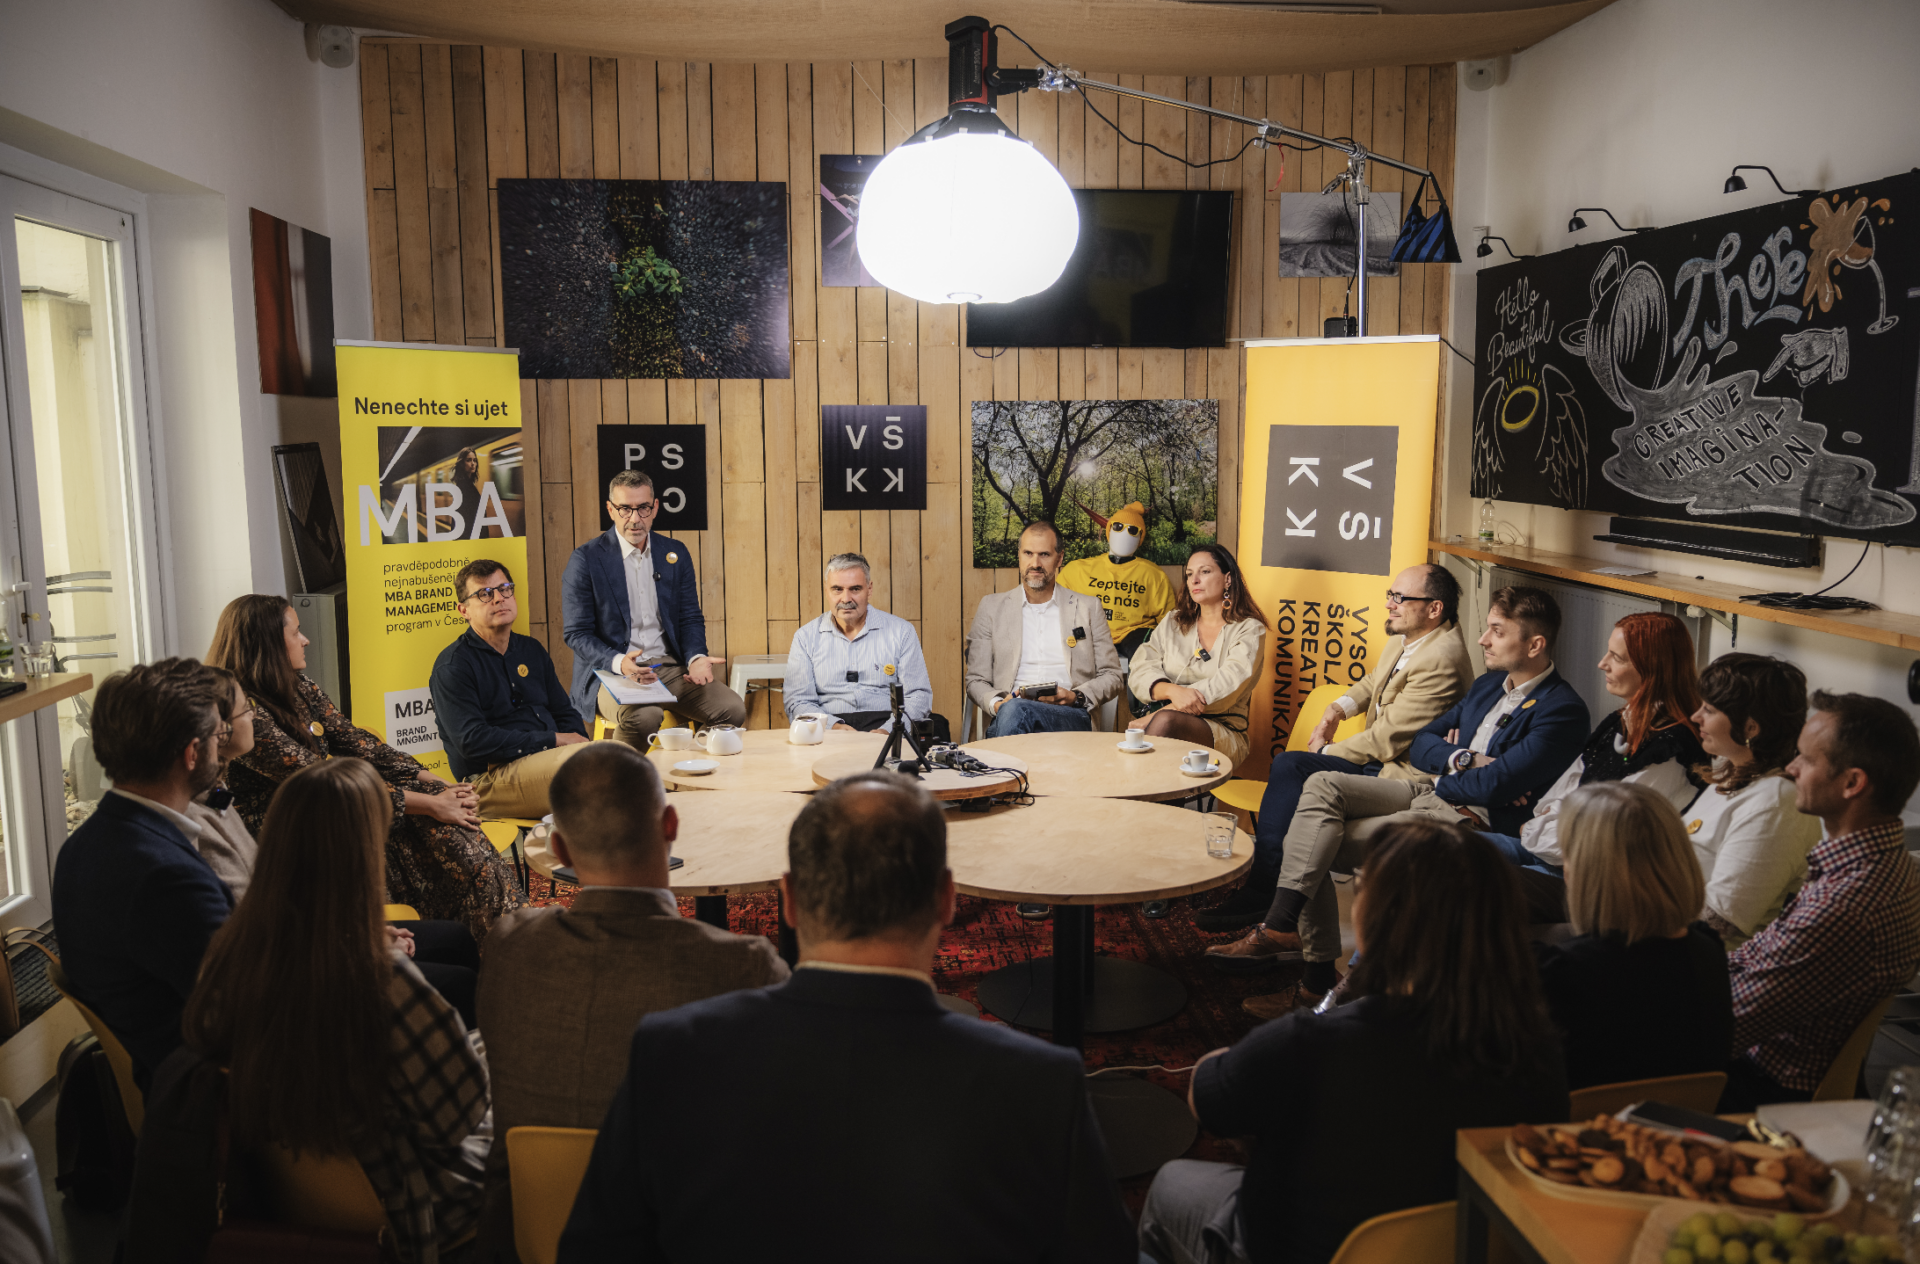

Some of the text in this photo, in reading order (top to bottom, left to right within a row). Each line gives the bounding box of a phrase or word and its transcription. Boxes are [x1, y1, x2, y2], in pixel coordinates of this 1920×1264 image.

[1495, 276, 1540, 331] Hello
[1673, 226, 1807, 358] There
[1487, 299, 1555, 377] Beautiful
[354, 397, 508, 420] Nenechte si ujet
[1633, 382, 1743, 460] CREATIVE
[1732, 434, 1816, 491] TION
[358, 481, 514, 546] MBA
[384, 572, 457, 589] nejnabušeněj
[1088, 576, 1146, 594] Zeptejte
[385, 587, 453, 602] MBA BRAND
[1114, 595, 1140, 608] nás
[386, 619, 432, 635] program
[1298, 601, 1321, 709] KREATI
[1348, 606, 1370, 687] VYSO
[395, 698, 436, 719] MBA
[396, 725, 427, 738] BRAND
[396, 731, 438, 746] MNGMNT
